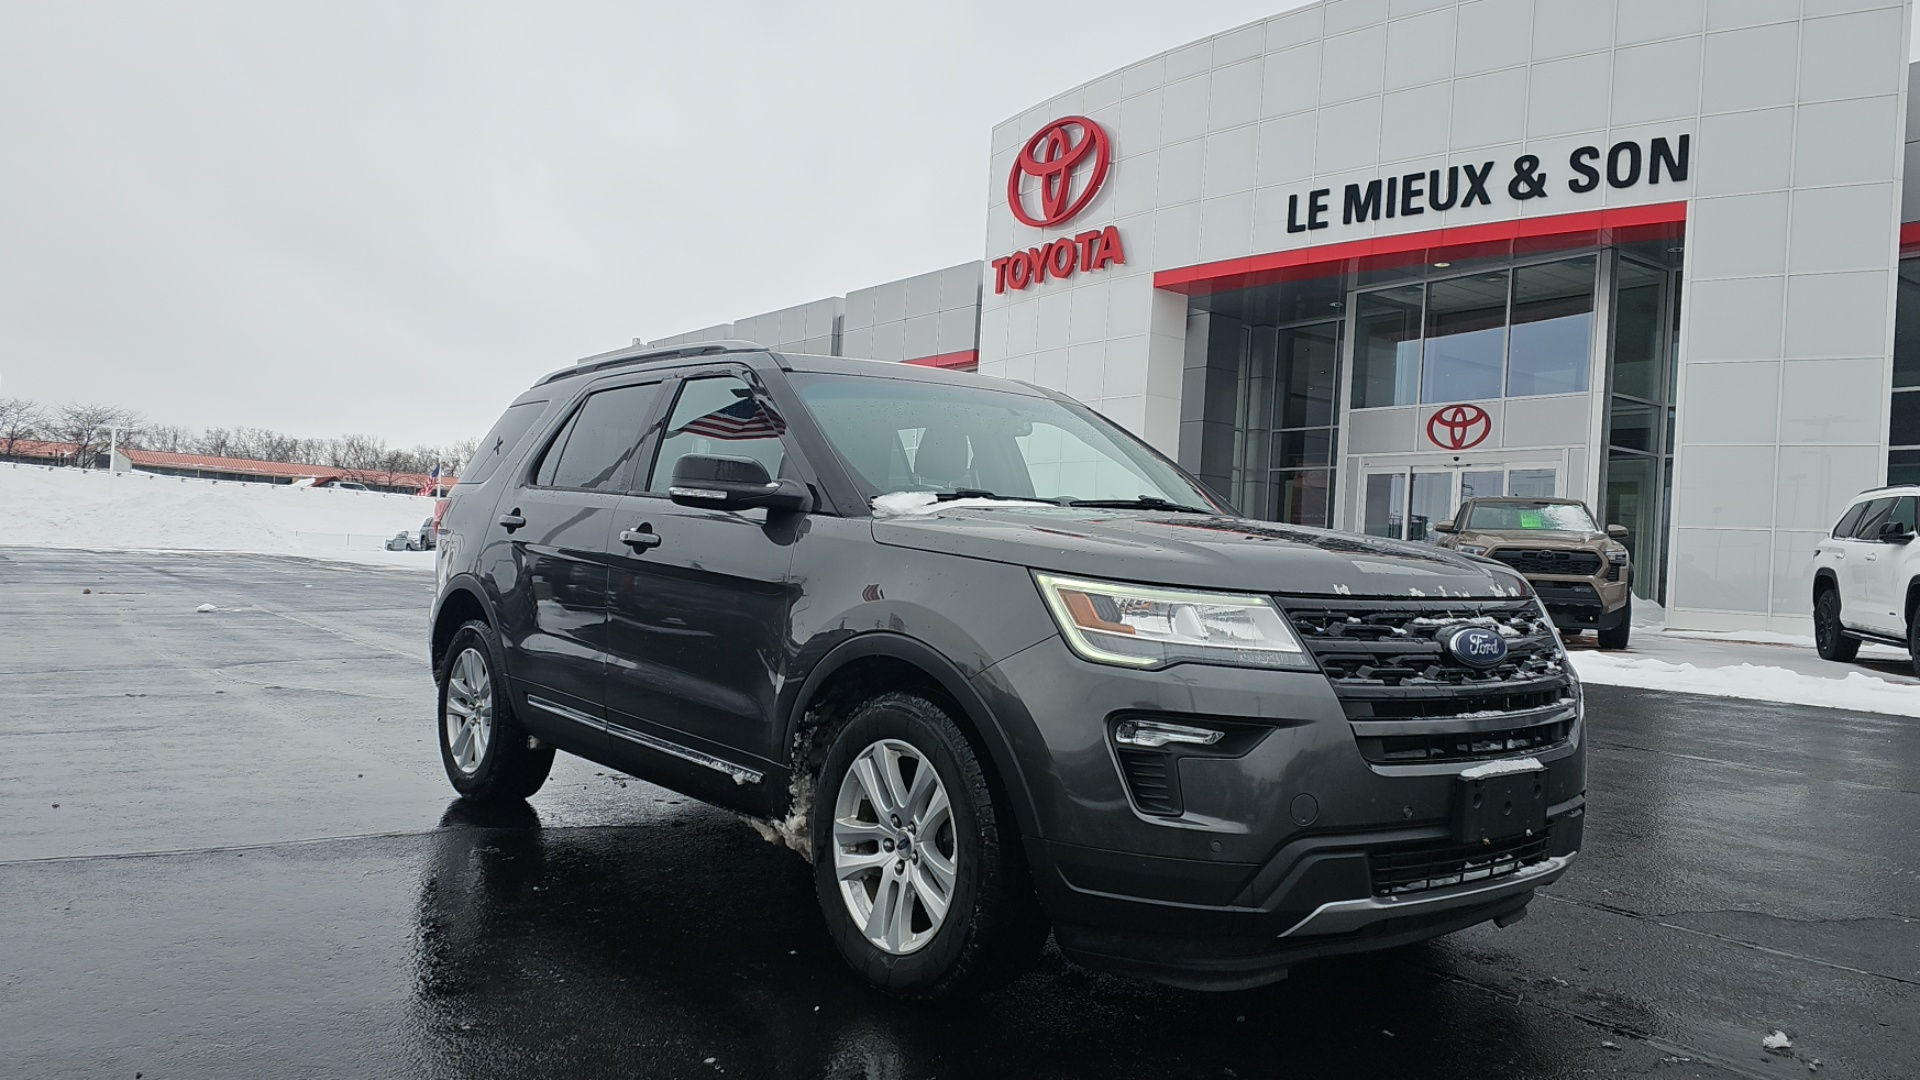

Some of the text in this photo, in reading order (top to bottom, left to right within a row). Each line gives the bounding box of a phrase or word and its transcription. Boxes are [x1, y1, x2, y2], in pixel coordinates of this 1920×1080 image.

[1287, 134, 1690, 233] LE MIEUX & SON
[992, 225, 1126, 295] TOYOTA
[1469, 633, 1500, 655] Ford
